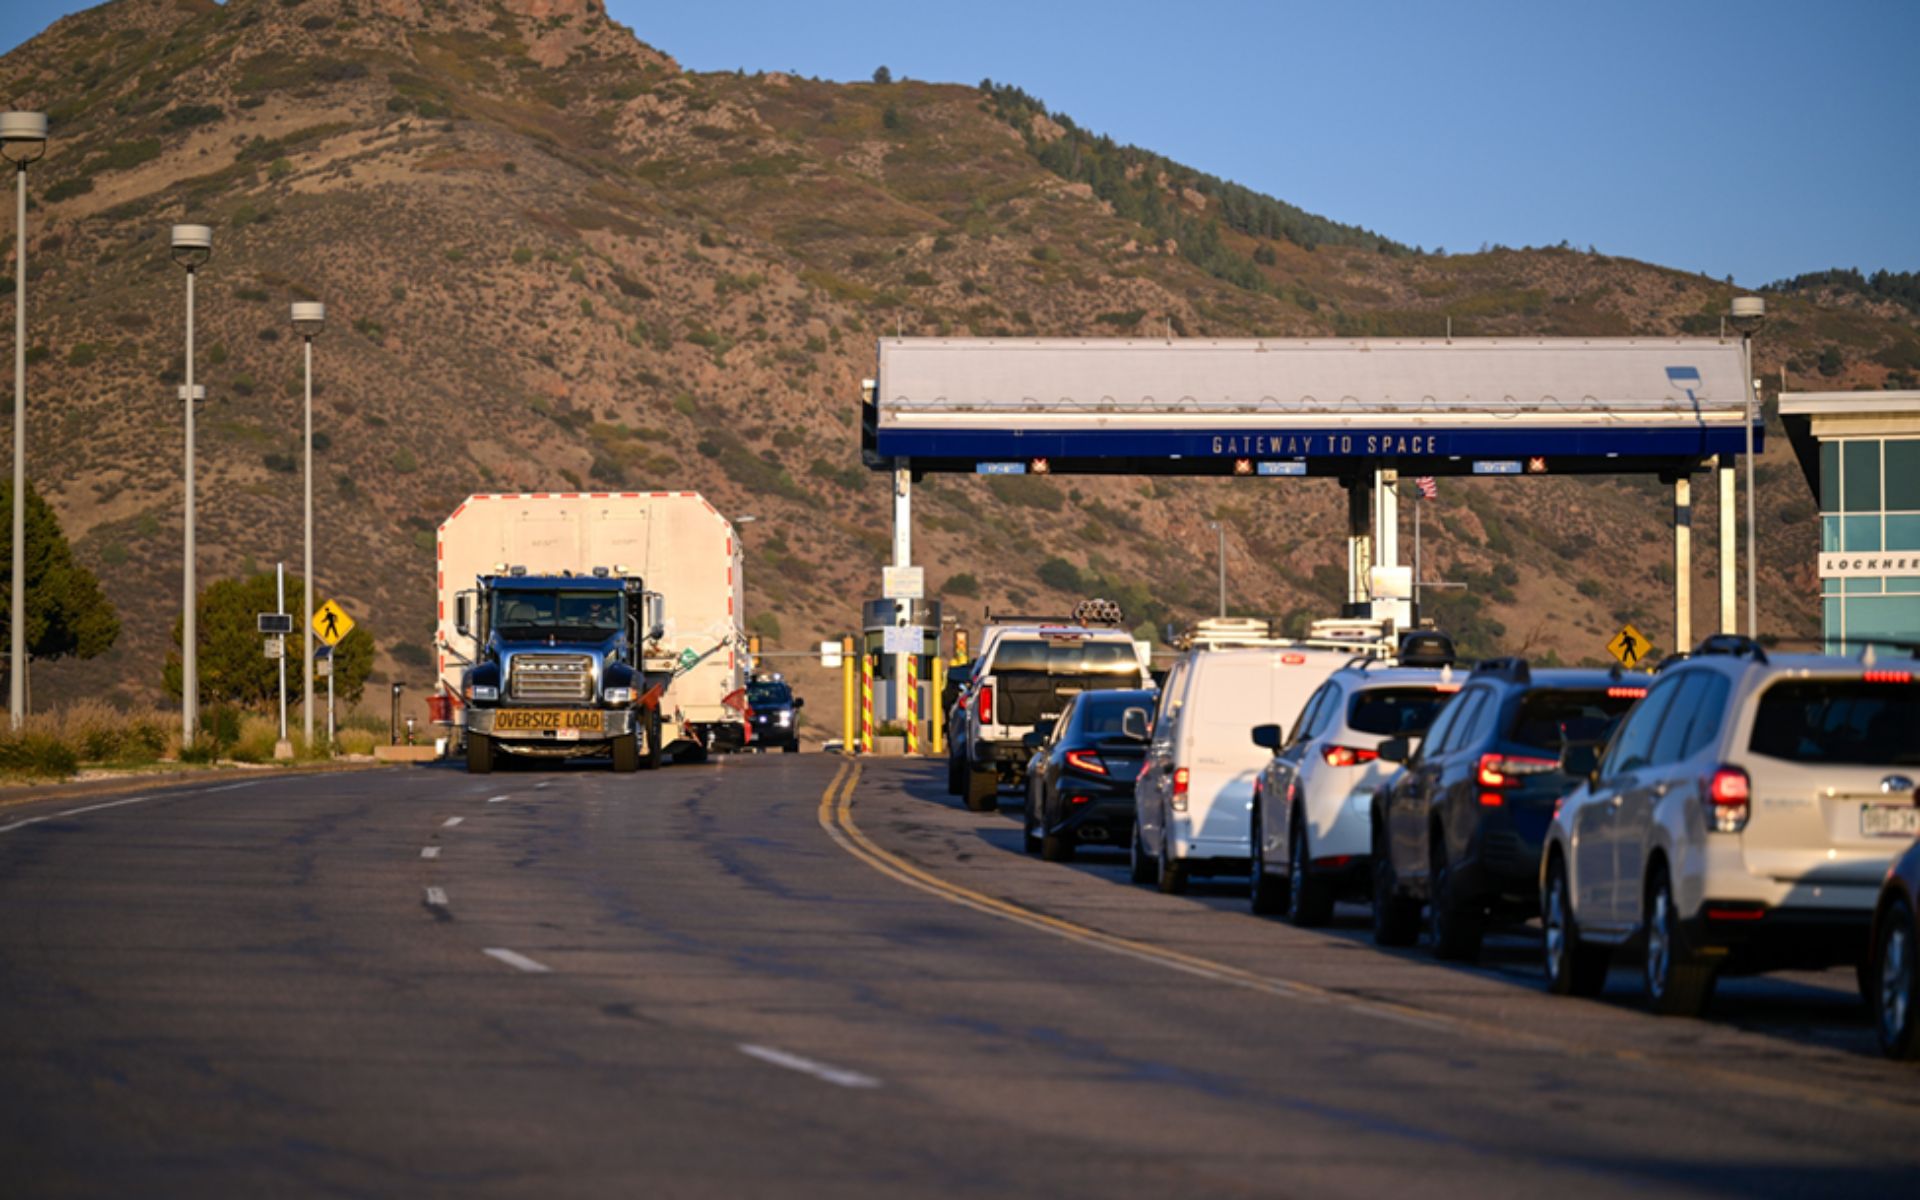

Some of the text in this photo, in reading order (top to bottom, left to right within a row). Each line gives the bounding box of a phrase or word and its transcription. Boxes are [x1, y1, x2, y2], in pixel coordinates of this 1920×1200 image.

[1212, 436, 1435, 453] GATEWAY TO SPACE
[1826, 559, 1919, 570] LOCKHEE
[497, 711, 600, 729] OVERSIZE LOAD
